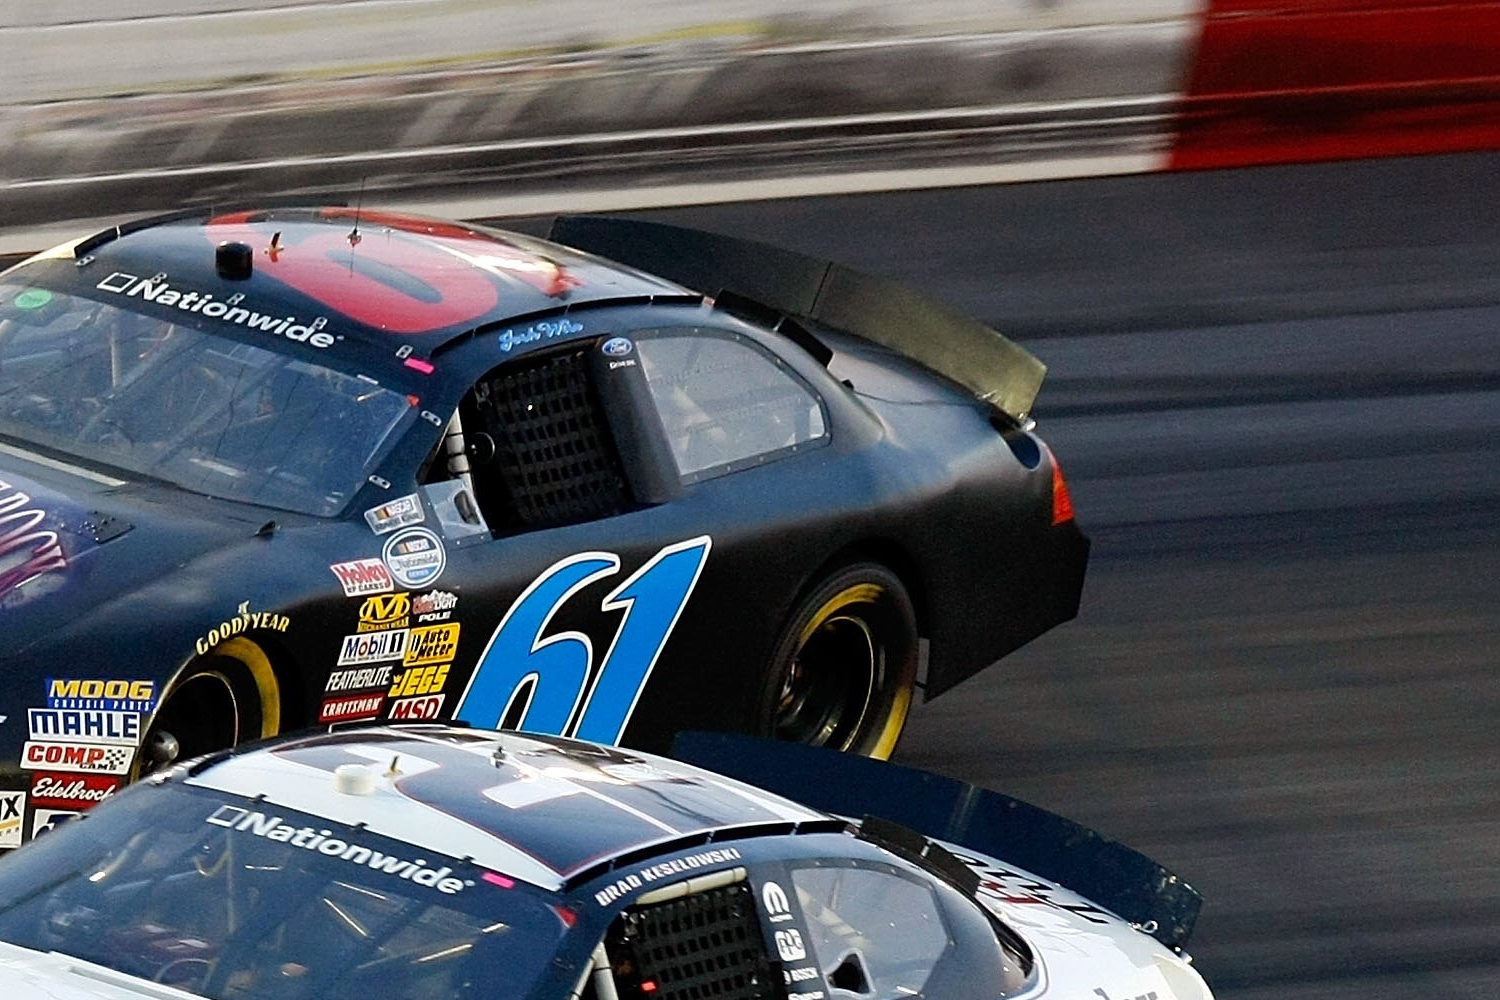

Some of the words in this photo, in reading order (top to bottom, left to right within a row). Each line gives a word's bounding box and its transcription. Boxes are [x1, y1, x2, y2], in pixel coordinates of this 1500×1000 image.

[127, 279, 335, 348] Nationwide
[333, 560, 391, 588] Holley
[418, 611, 451, 623] POLE
[196, 611, 290, 656] GOODYEAR
[343, 633, 389, 659] Mobil
[423, 629, 451, 644] Auto
[451, 535, 712, 746] 61
[50, 679, 154, 700] MOOG
[325, 665, 393, 692] FEATHERLITE
[388, 664, 452, 698] JEGS
[53, 698, 105, 710] CHASSIS
[113, 700, 151, 712] PARTS
[322, 696, 383, 718] CRAFTSMAN
[394, 697, 443, 720] MSD
[30, 710, 138, 739] MAHLE
[27, 745, 105, 766] COMP
[78, 762, 118, 771] CAMS
[235, 811, 465, 894] Nationwide
[640, 847, 742, 882] KESELOWSKI
